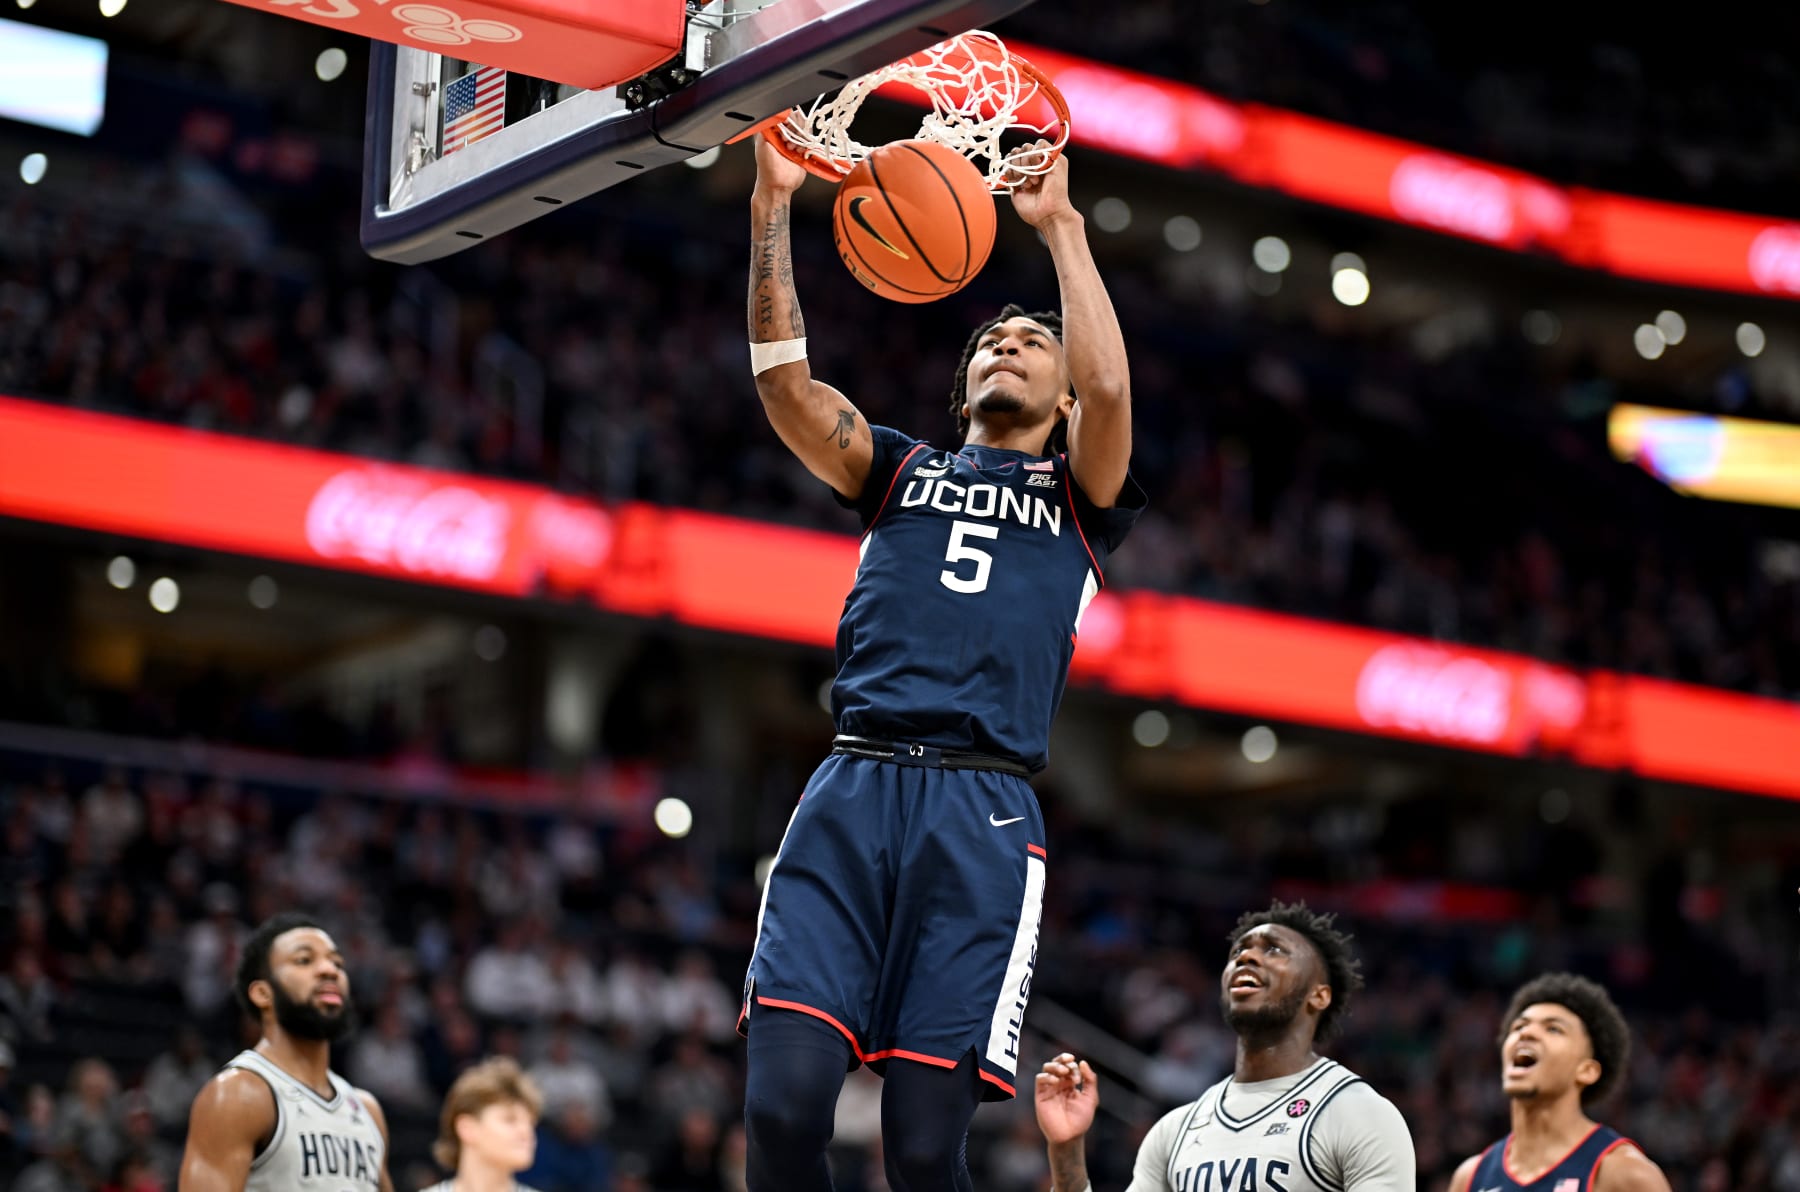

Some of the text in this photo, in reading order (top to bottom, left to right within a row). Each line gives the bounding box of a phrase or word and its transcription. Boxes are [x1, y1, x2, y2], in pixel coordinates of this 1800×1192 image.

[760, 294, 772, 325] XXV
[1024, 479, 1058, 488] EAST
[1029, 473, 1052, 481] BIG
[900, 479, 1062, 537] UCONN
[939, 519, 1000, 594] 5
[300, 1133, 379, 1186] HOYAS
